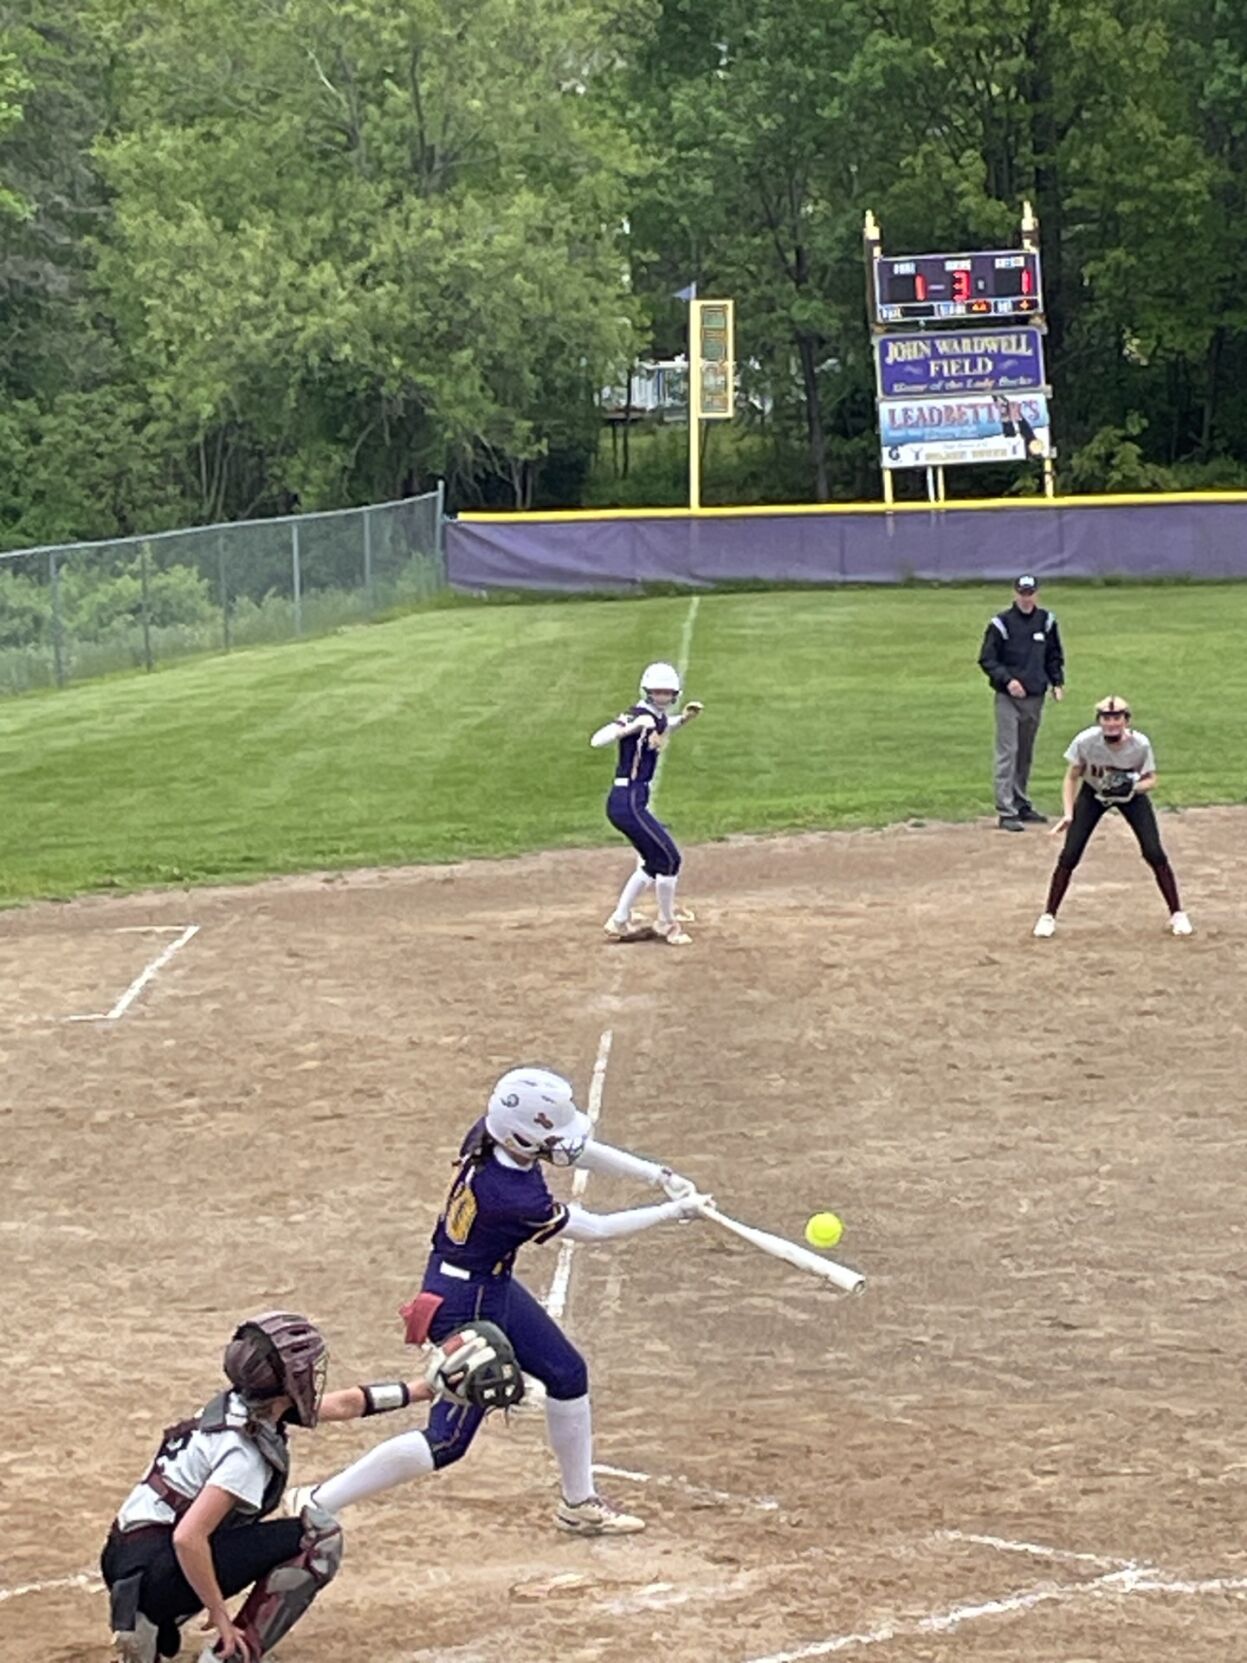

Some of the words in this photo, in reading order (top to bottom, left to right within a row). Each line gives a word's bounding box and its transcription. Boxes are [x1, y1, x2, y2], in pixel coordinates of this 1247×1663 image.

[953, 270, 970, 301] 3
[885, 341, 930, 364] JOHN
[934, 335, 1032, 355] WARDWELL
[929, 357, 992, 376] FIELD
